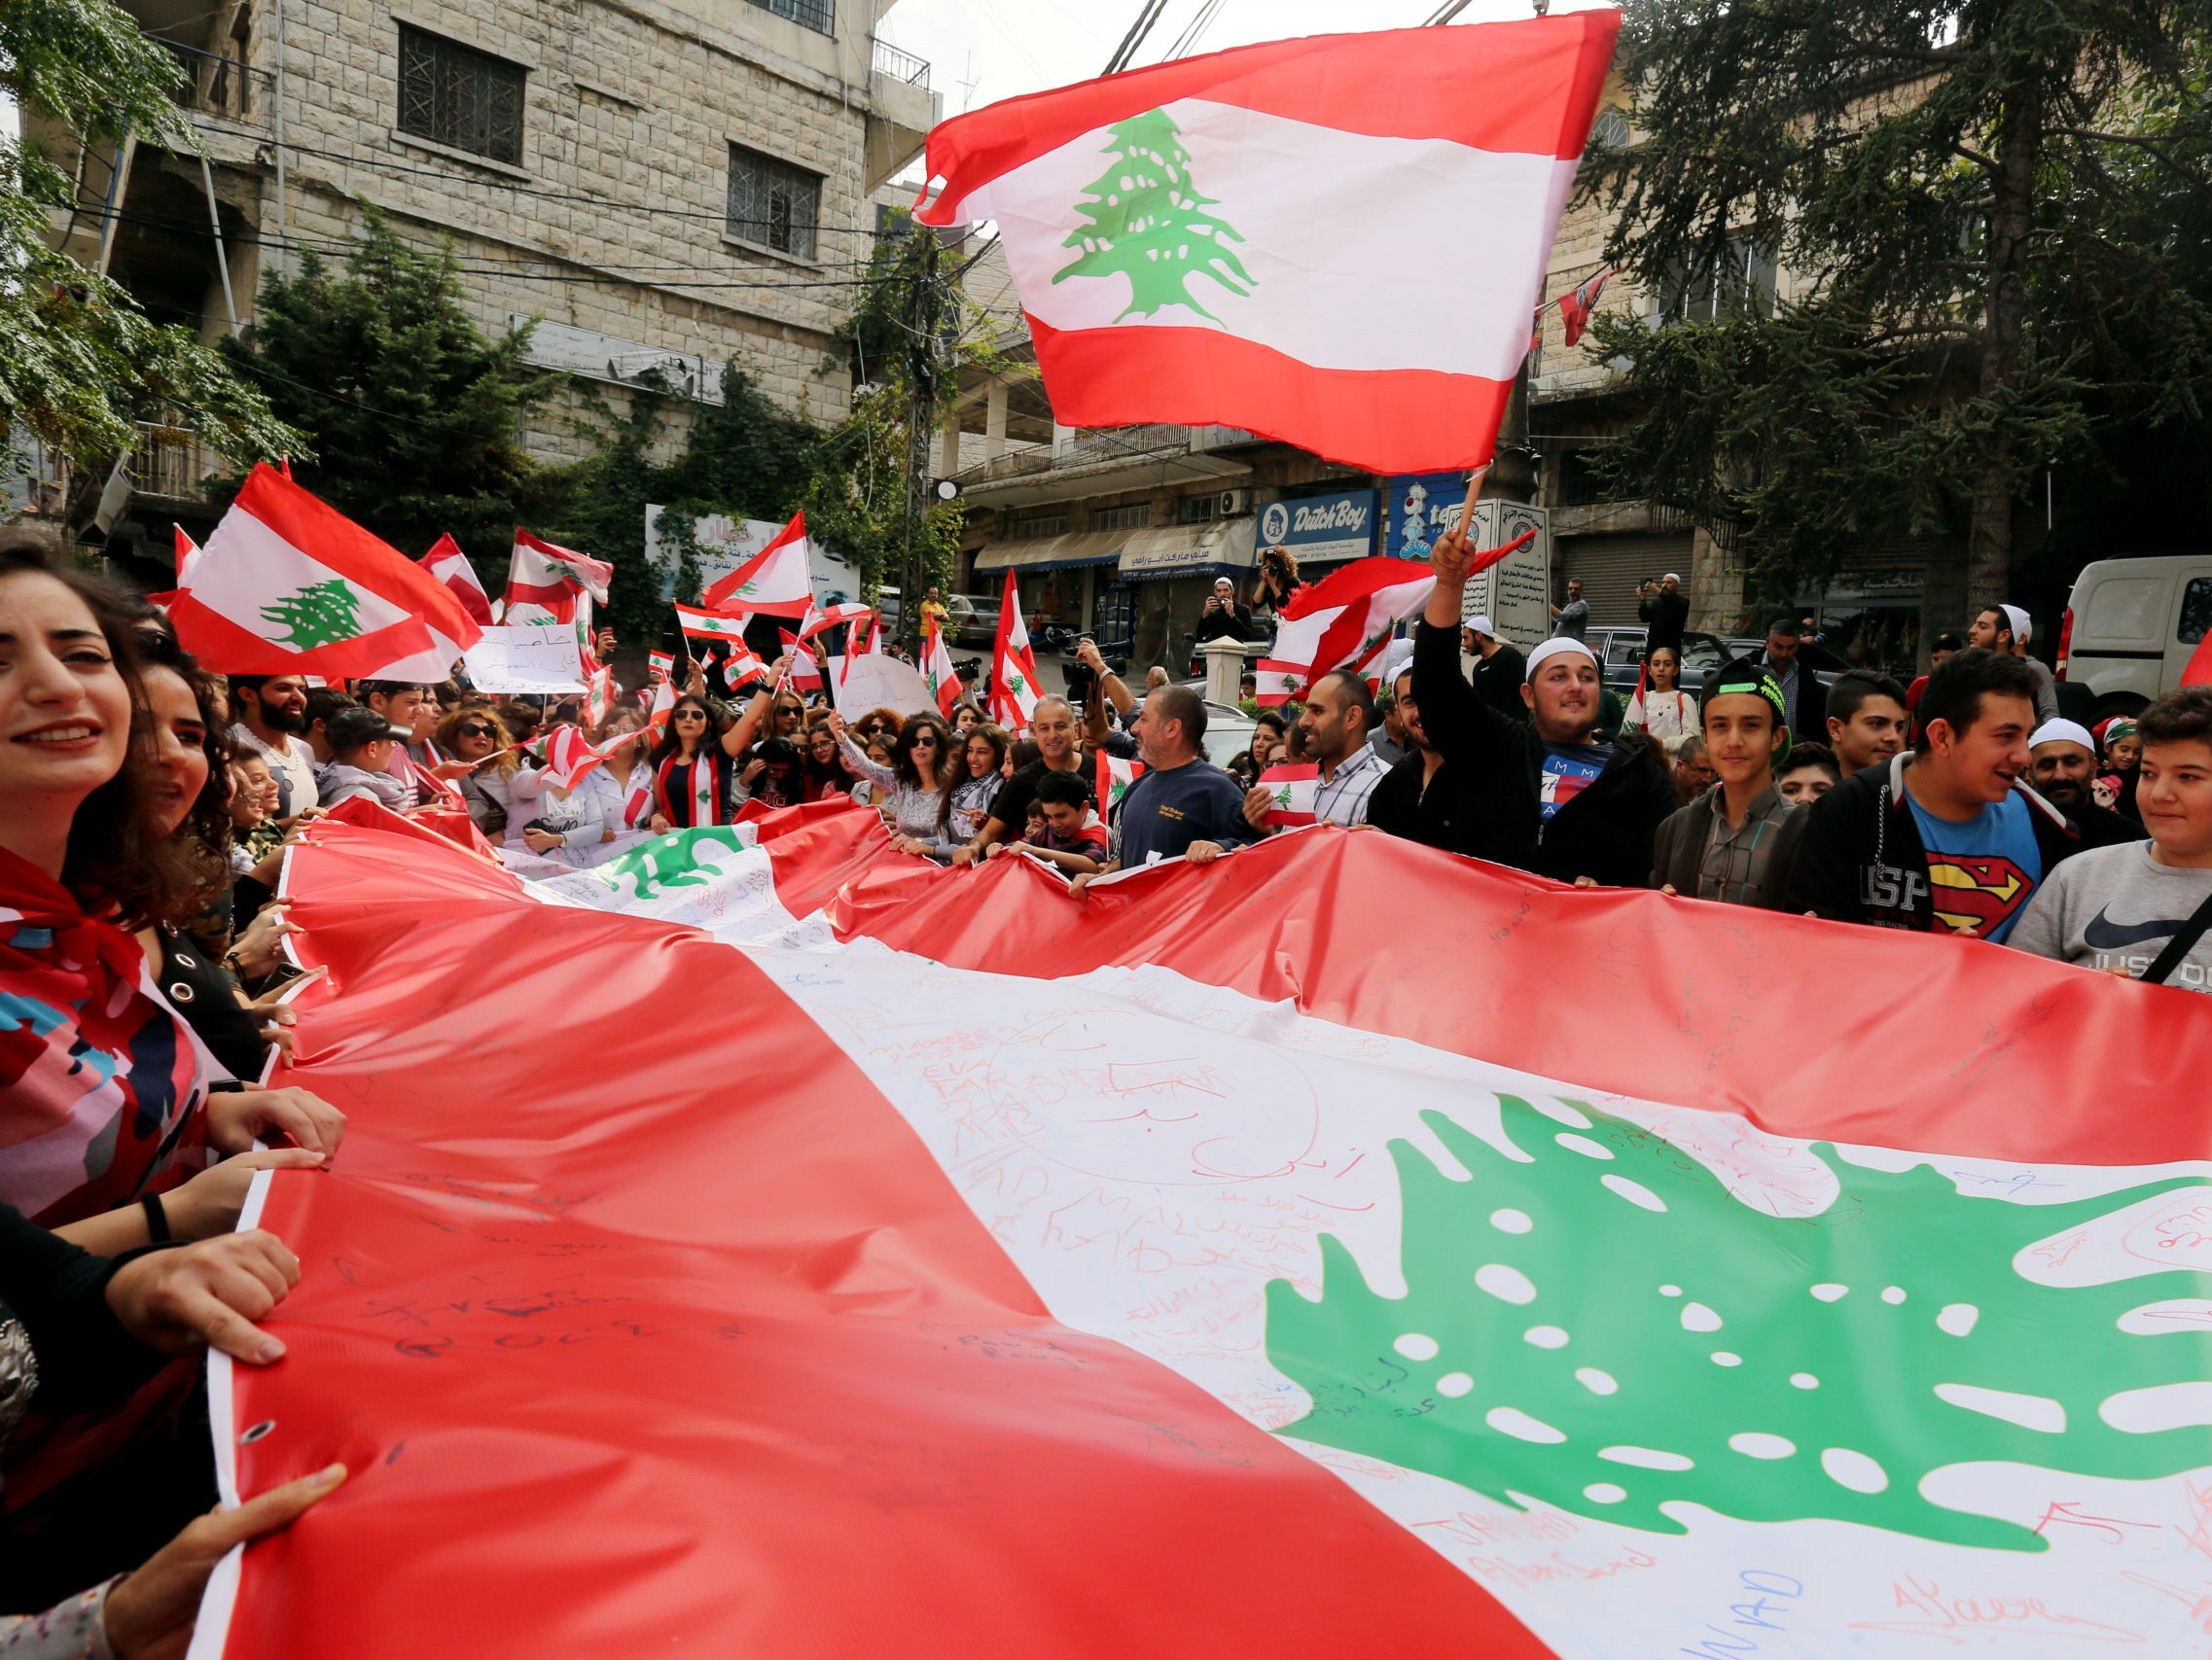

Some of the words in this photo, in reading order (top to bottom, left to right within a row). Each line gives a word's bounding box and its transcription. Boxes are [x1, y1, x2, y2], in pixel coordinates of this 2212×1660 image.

[1294, 505, 1336, 532] Dutch
[1336, 499, 1368, 532] Boy
[2087, 953, 2157, 978] JUS
[2180, 963, 2212, 988] D
